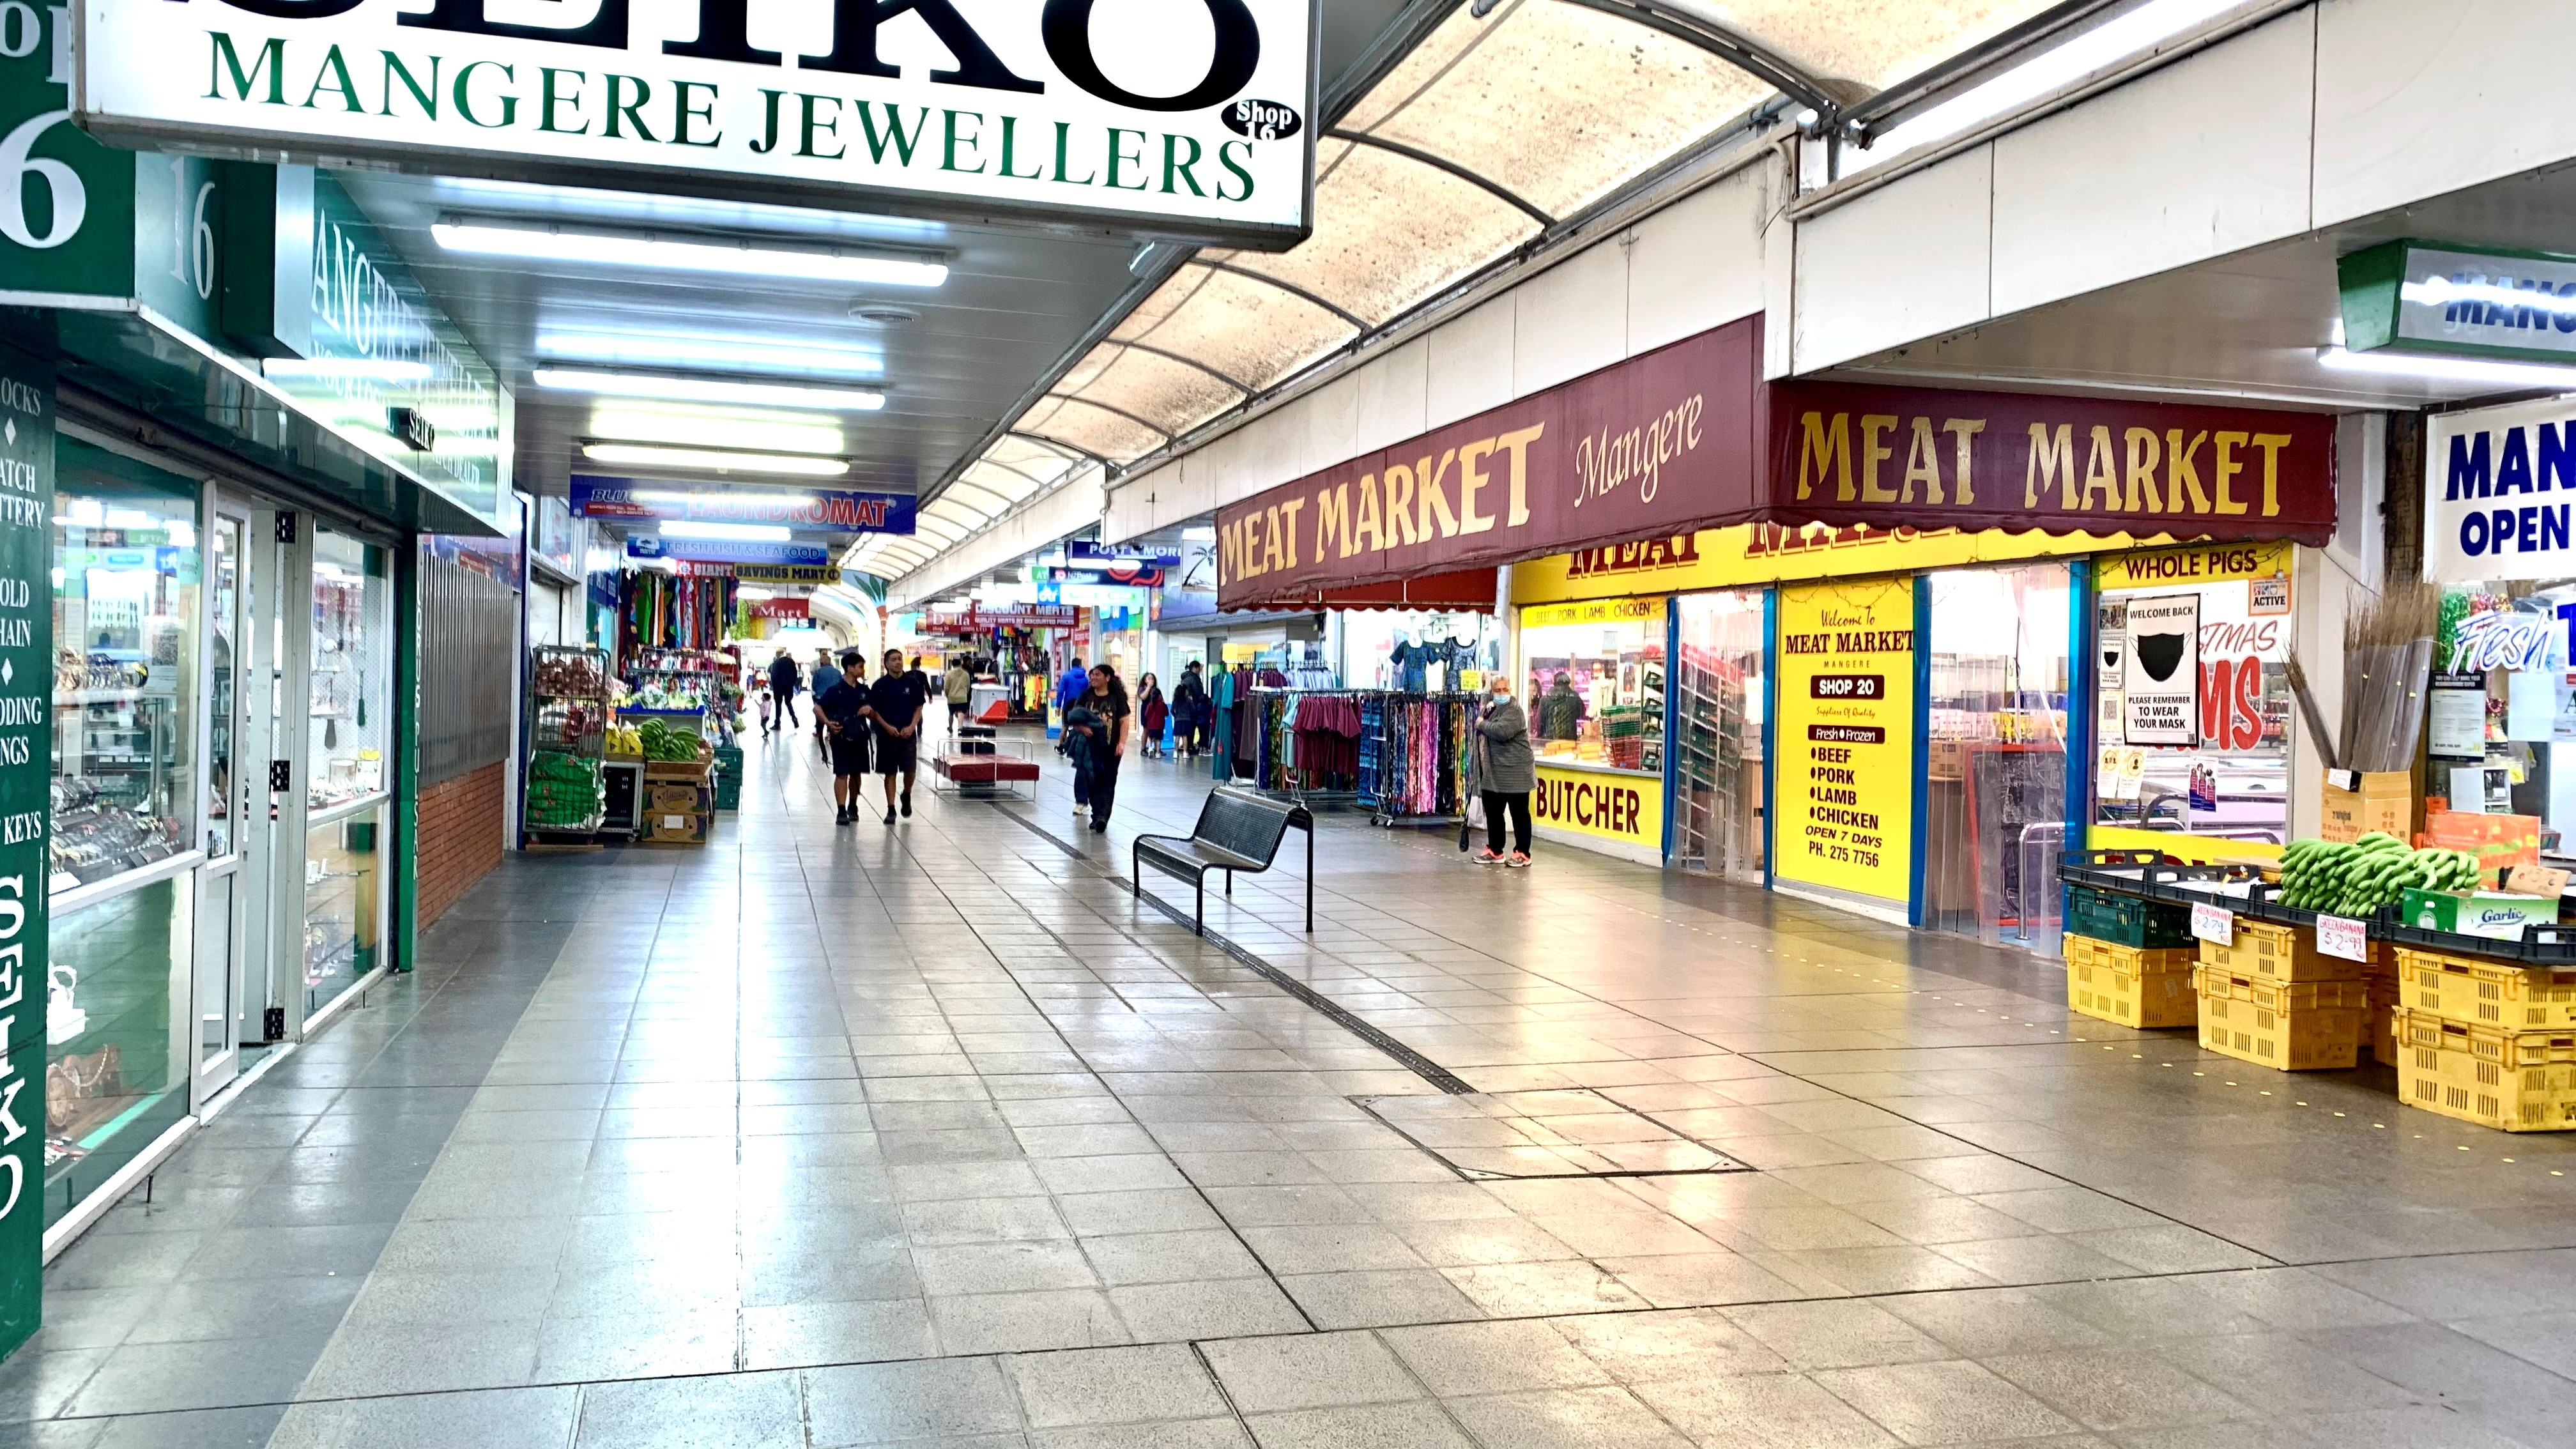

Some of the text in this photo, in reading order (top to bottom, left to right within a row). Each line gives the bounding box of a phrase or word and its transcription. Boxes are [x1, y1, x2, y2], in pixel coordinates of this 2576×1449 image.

[200, 30, 723, 148] MANGERE
[749, 87, 1255, 202] JEWELLERS
[1237, 100, 1292, 130] Shop
[1245, 121, 1276, 141] 16
[170, 156, 215, 300] 16
[409, 410, 434, 451] SEIKO
[1796, 411, 2292, 518] MEAT MARKET
[1220, 391, 1705, 587] MEAT MARKET Mangere
[688, 490, 888, 528] LAUNDROMAT
[2460, 503, 2570, 557] OPEN
[756, 545, 820, 560] SEAFOOD
[694, 564, 733, 576] GIANT
[735, 565, 789, 579] SAVINGS
[792, 567, 826, 580] MART
[2126, 549, 2258, 581] WHOLE PIGS
[976, 602, 1075, 615] DISCOUNT MEATS
[2253, 595, 2285, 606] ACTIVE
[759, 606, 802, 618] Mart
[1537, 601, 1650, 624] BEEF PORK LAMB CHICKEN
[1821, 609, 1862, 627] Welcome
[2129, 606, 2194, 619] WELCOME BACK
[1785, 630, 1913, 654] MEAT MARKET
[2448, 609, 2556, 677] Fresh
[1819, 678, 1874, 695] SHOP 20
[1853, 707, 1875, 719] Quality
[2138, 707, 2179, 716] TO WEAR
[1816, 727, 1876, 742] Fresh Frozen
[2134, 719, 2186, 729] YOUR MASK
[1818, 747, 1851, 763] BEEF
[1818, 767, 1855, 785] PORK
[1537, 778, 1640, 834] BUTCHER
[1817, 786, 1857, 805] LAMB
[4, 810, 42, 845] KEYS
[1817, 806, 1878, 831] CHICKEN
[1805, 825, 1882, 848] OPEN 7 DAYS
[1809, 840, 1879, 868] PH. 275 7756
[2481, 907, 2526, 923] Garlic
